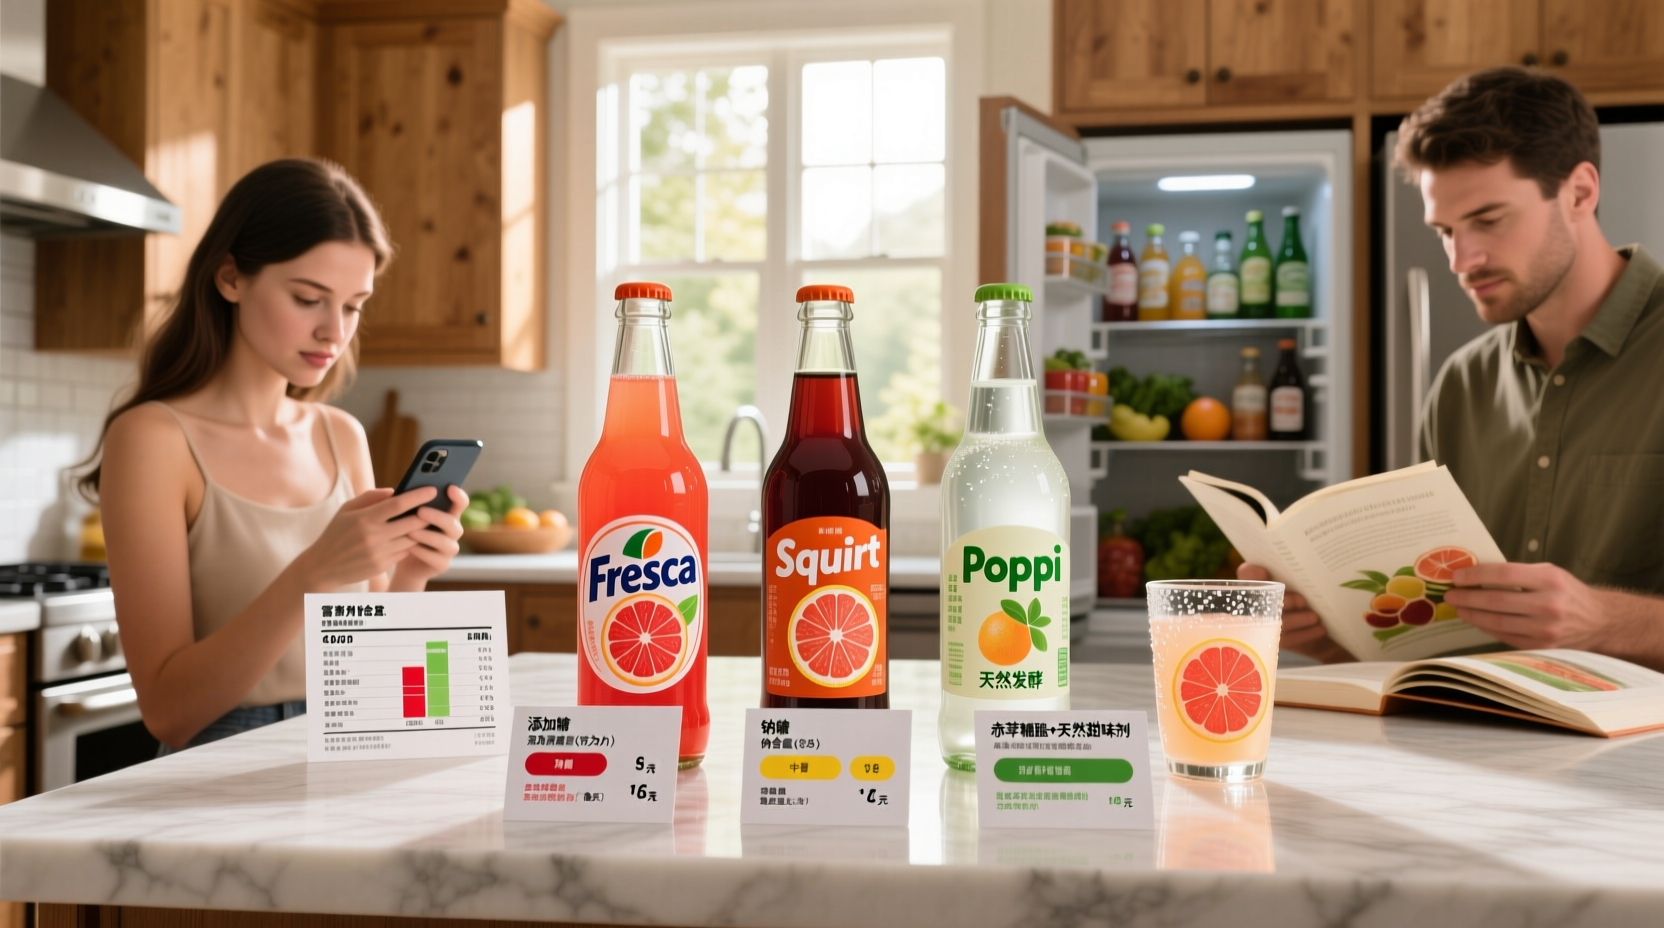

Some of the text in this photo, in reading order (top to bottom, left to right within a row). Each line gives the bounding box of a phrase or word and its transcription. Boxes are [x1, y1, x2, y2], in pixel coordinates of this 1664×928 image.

[589, 554, 697, 603] Fresca
[775, 534, 881, 586] Squirt
[962, 544, 1061, 592] Poppi
